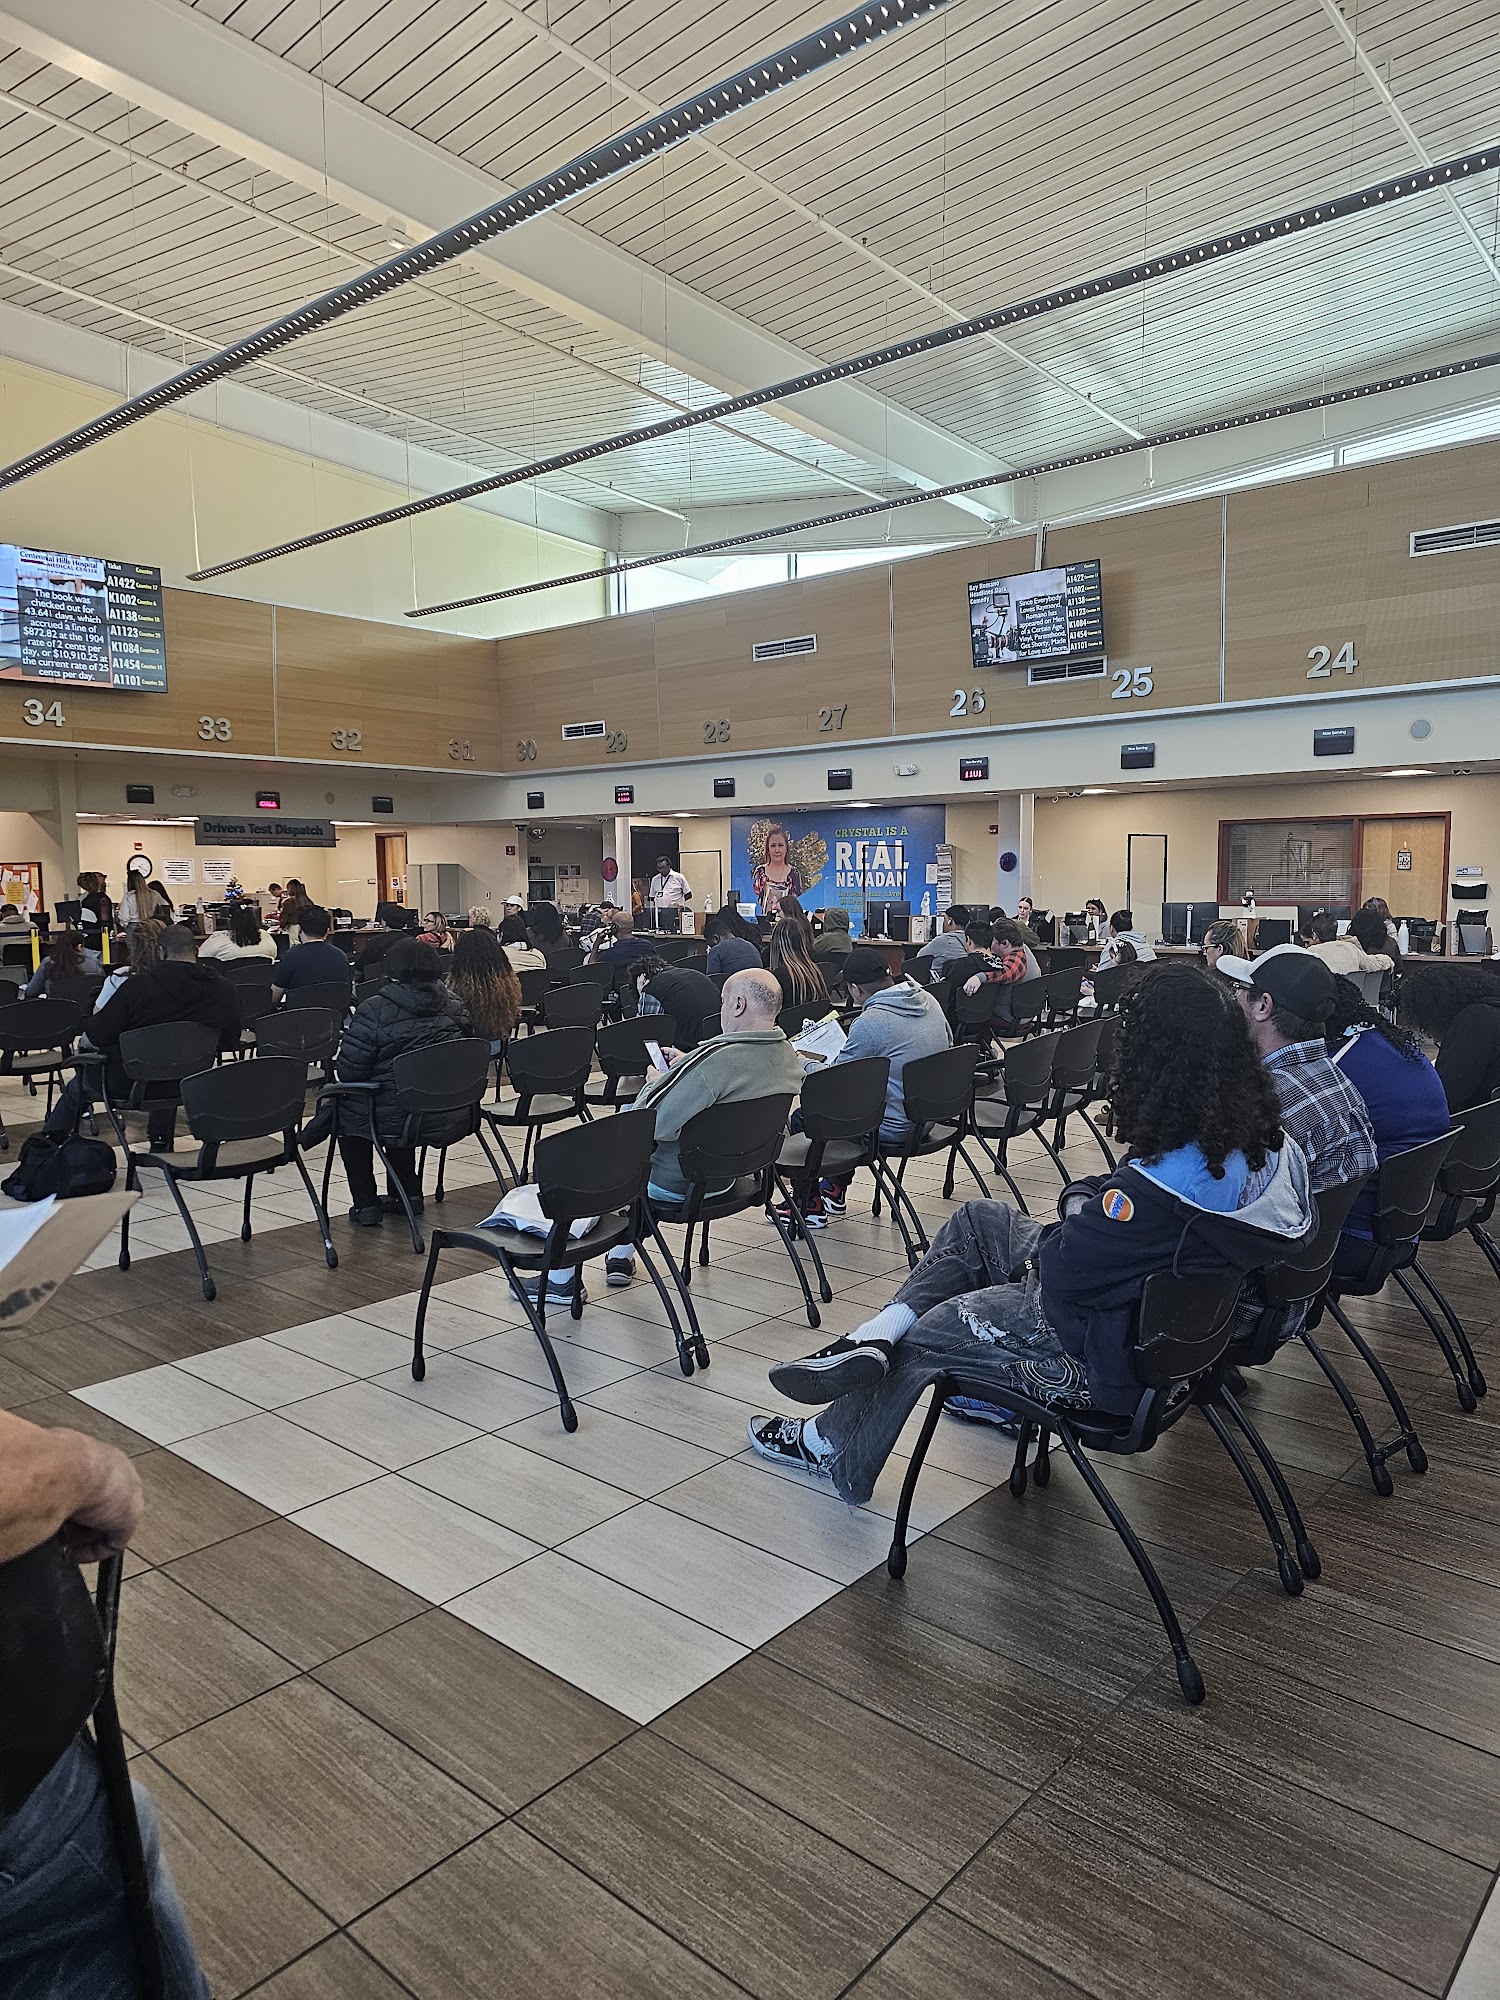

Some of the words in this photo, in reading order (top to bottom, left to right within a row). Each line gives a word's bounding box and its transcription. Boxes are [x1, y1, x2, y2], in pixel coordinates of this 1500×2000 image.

[47, 563, 73, 571] MEDICAL
[73, 560, 98, 568] Hospital
[107, 575, 136, 589] A1422
[1067, 574, 1084, 584] A1422
[33, 588, 50, 598] The
[52, 592, 73, 602] book
[75, 596, 91, 604] was
[109, 592, 137, 606] K1002
[970, 597, 990, 605] Comedy
[1034, 595, 1062, 604] Everybody
[1068, 596, 1086, 606] A1138
[31, 598, 65, 610] checked
[67, 604, 81, 612] out
[82, 605, 95, 614] for
[55, 611, 75, 622] days,
[77, 615, 102, 624] which
[110, 608, 138, 622] A1138
[1026, 612, 1047, 620] Romano
[1069, 608, 1086, 618] A1123
[30, 620, 63, 629] accrued
[72, 623, 87, 632] fine
[88, 625, 97, 633] of
[1019, 619, 1043, 630] appeared
[23, 626, 57, 638] $872.82
[69, 633, 83, 641] the
[85, 634, 104, 643] 1904
[110, 625, 138, 638] A1123
[1070, 630, 1087, 640] A1454
[57, 640, 63, 649] 2
[65, 643, 86, 651] cents
[88, 645, 102, 653] per
[111, 641, 139, 654] K1084
[1042, 646, 1051, 654] and
[1071, 641, 1087, 650] A1101
[53, 649, 98, 661] $10,910.25
[1307, 642, 1359, 679] 24
[22, 657, 36, 665] the
[38, 659, 69, 668] current
[71, 662, 87, 670] rate
[89, 663, 98, 671] of
[99, 663, 109, 672] 25
[113, 657, 140, 670] A1454
[39, 669, 61, 677] cents
[79, 672, 95, 681] day.
[114, 674, 141, 686] A1101
[1111, 667, 1154, 699] 25
[949, 687, 986, 717] 26
[23, 698, 66, 727] 34
[817, 704, 848, 731] 27
[198, 716, 232, 741] 33
[703, 719, 730, 744] 28
[331, 727, 362, 751] 32
[605, 730, 627, 753] 29
[449, 739, 475, 761] 31
[515, 739, 537, 761] 30
[204, 822, 245, 834] Drivers
[248, 823, 272, 834] Test
[275, 824, 324, 837] Dispatch
[835, 827, 883, 838] CRYSTAL
[886, 826, 897, 836] IS
[900, 825, 908, 835] A
[836, 840, 909, 870] REAL
[836, 871, 907, 887] NEVADAN
